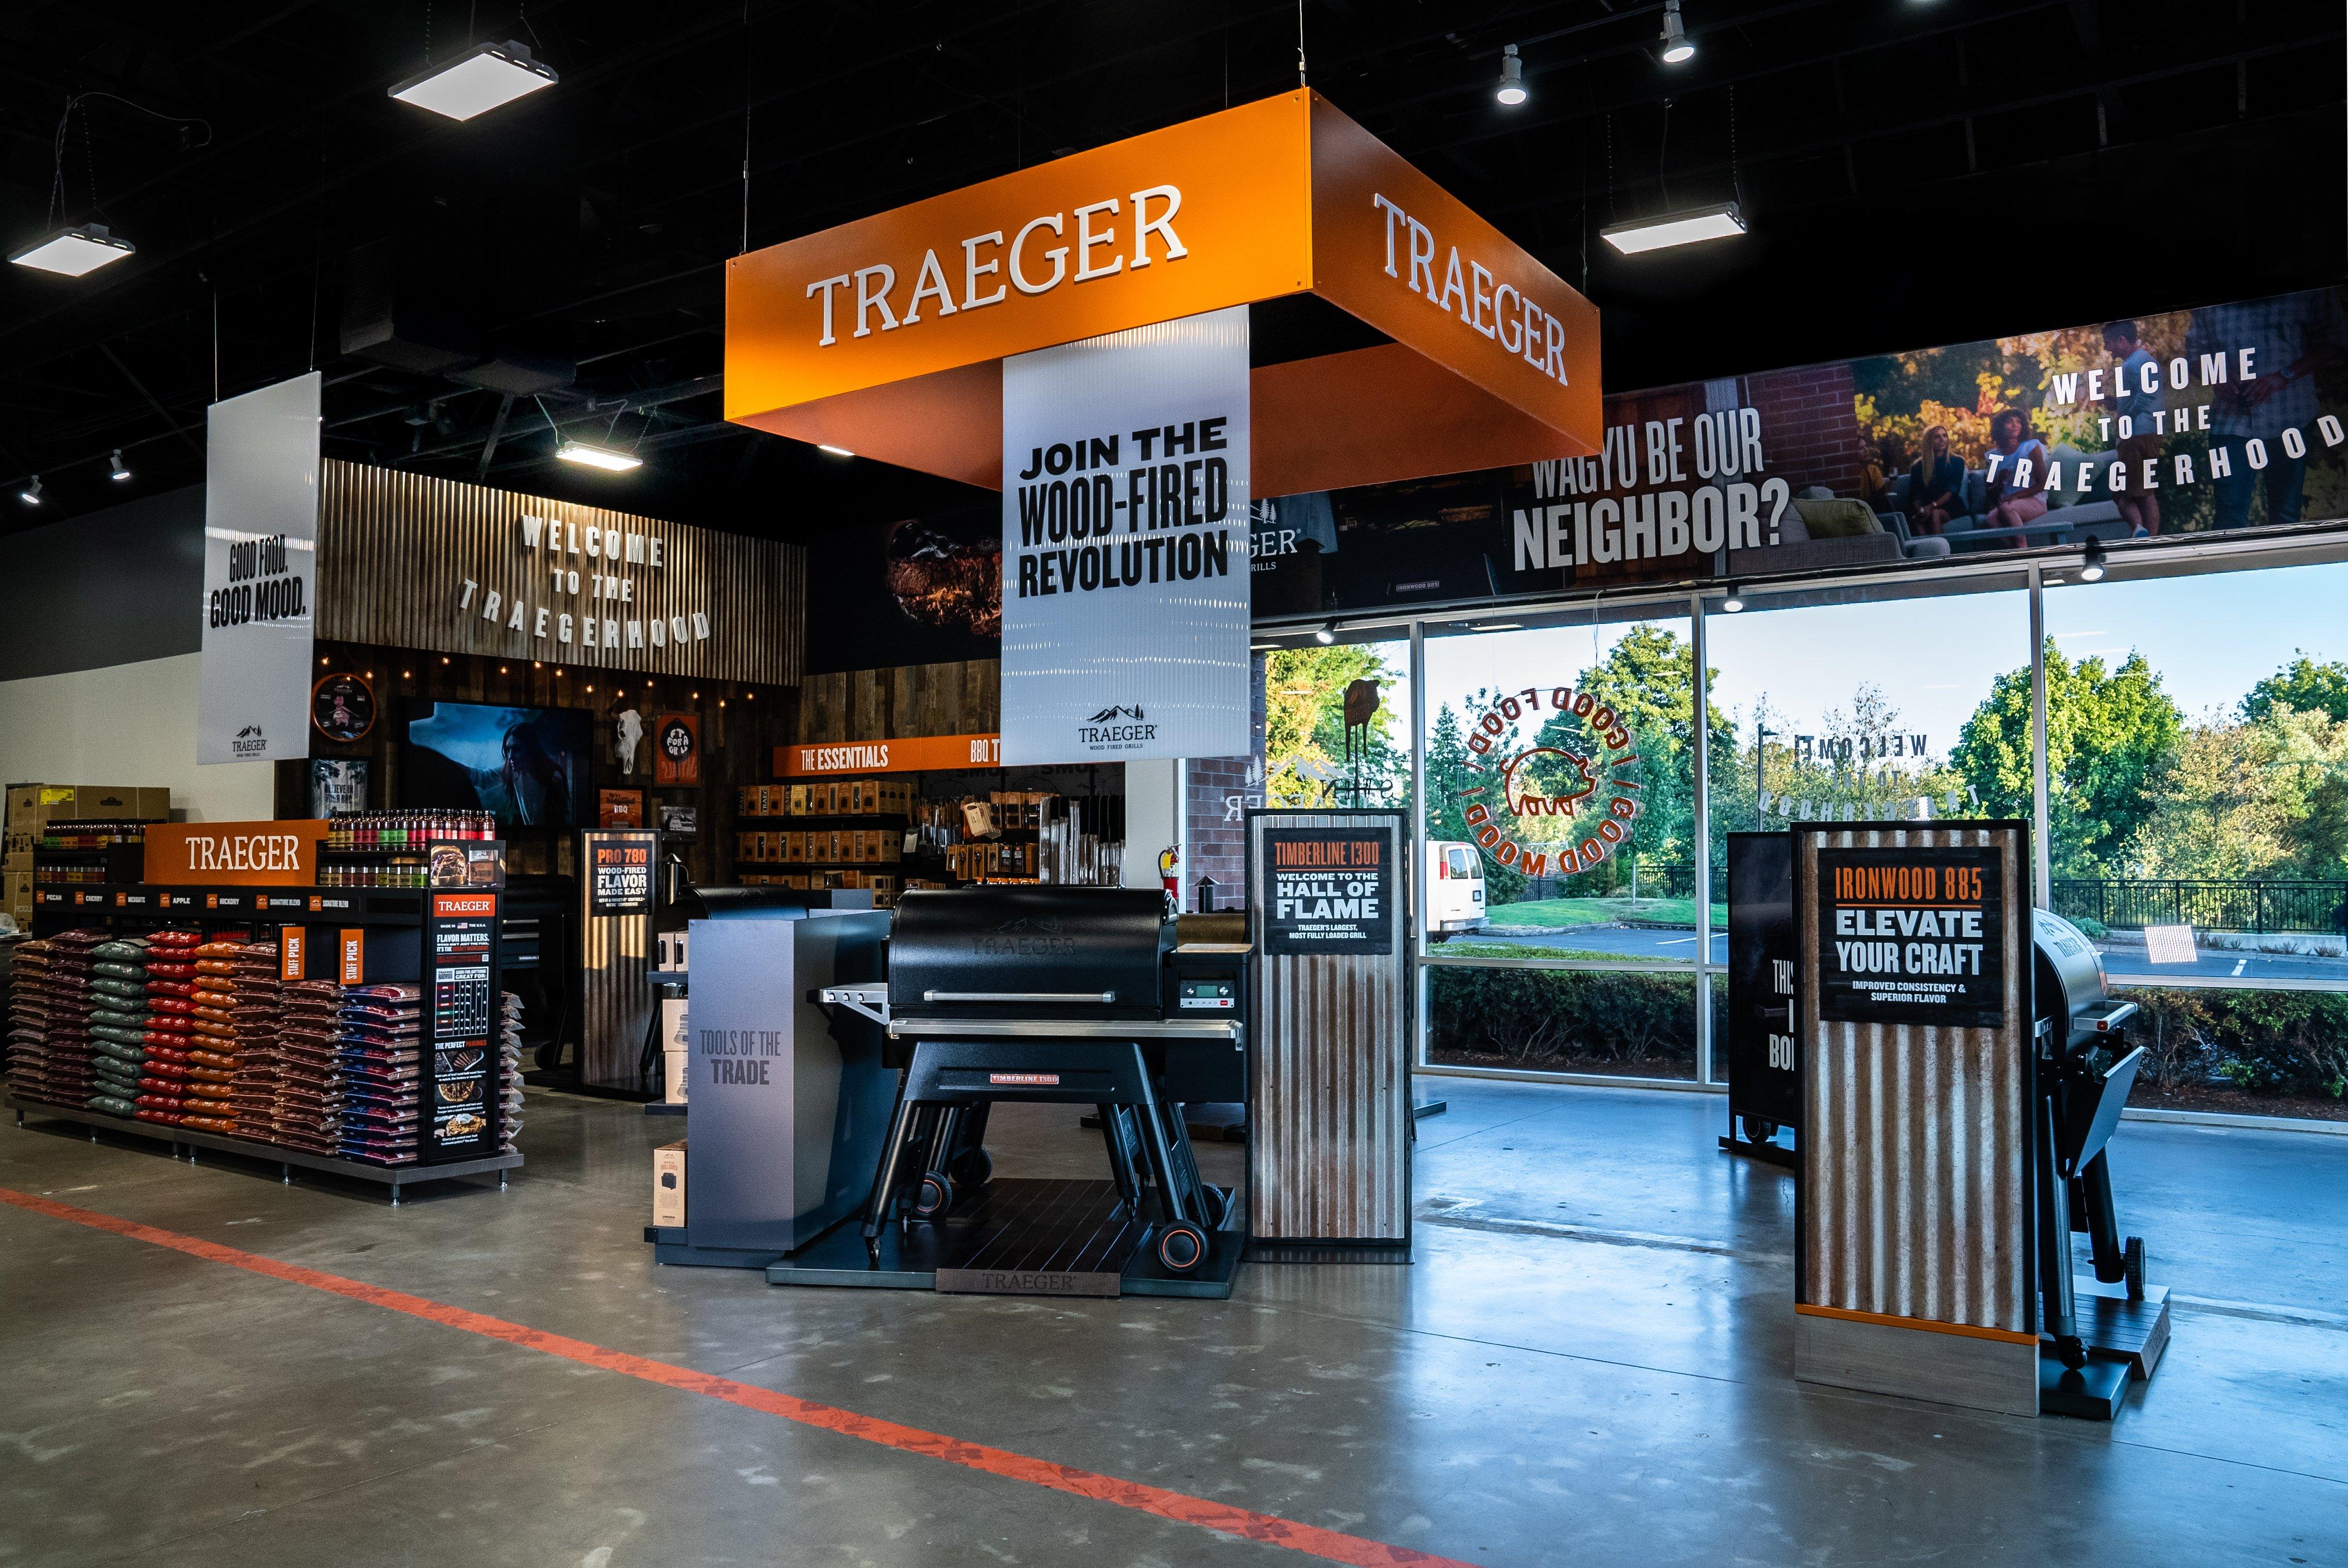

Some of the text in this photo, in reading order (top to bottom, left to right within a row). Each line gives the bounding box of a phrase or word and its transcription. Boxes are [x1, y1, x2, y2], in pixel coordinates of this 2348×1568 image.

[806, 185, 1188, 347] TRAEGER
[1374, 193, 1568, 386] TRAEGER
[2053, 347, 2257, 405] WELCOME
[2098, 405, 2212, 442] TO THE
[1020, 417, 1227, 480] JOIN THE
[1533, 407, 1764, 499] WAGYU BE OUR
[1986, 415, 2345, 492] TRAEGERHOOD
[1018, 457, 1227, 546] WOOD-FIRED
[1514, 477, 1789, 571] NEIGHBOR?
[521, 515, 663, 567] WELCOME
[229, 534, 288, 583] GOOD FOOD.
[1018, 530, 1227, 598] REVOLUTION
[210, 576, 306, 628] GOOD MOOD.
[554, 569, 632, 602] TO THE
[458, 579, 710, 649] TRAEGERHOOD
[232, 739, 265, 752] TRAEGER
[1079, 725, 1156, 742] TRAEGER
[801, 744, 888, 771] THE ESSENTIALS
[970, 739, 989, 763] BBQ
[614, 805, 627, 814] BBQ
[185, 835, 300, 871] TRAEGER
[598, 849, 646, 863] PRO 780
[1275, 842, 1379, 865] TIMBERLINE 1300
[598, 874, 647, 888] FLAVOR
[1277, 882, 1379, 897] HALL OF
[1836, 867, 1982, 900] IRONWOOD 885
[438, 901, 490, 911] TRAEGER
[1277, 899, 1379, 919] FLAME
[437, 933, 489, 942] FLAVOR MATTERS.
[1836, 909, 1983, 937] ELEVATE
[288, 938, 299, 975] STAFF PICK
[346, 940, 357, 979] STAFF PICK
[972, 937, 1075, 956] TRAEGER
[1835, 941, 1983, 975] YOUR CRAFT
[1853, 981, 1966, 993] IMPROVED CONSISTENCY &
[1871, 993, 1946, 1003] SUPERIOR FLAVOR
[700, 1030, 781, 1056] TOOLS OF THE
[1770, 1034, 1794, 1071] BO
[711, 1059, 770, 1085] TRADE
[982, 1274, 1073, 1290] TRAEGER
